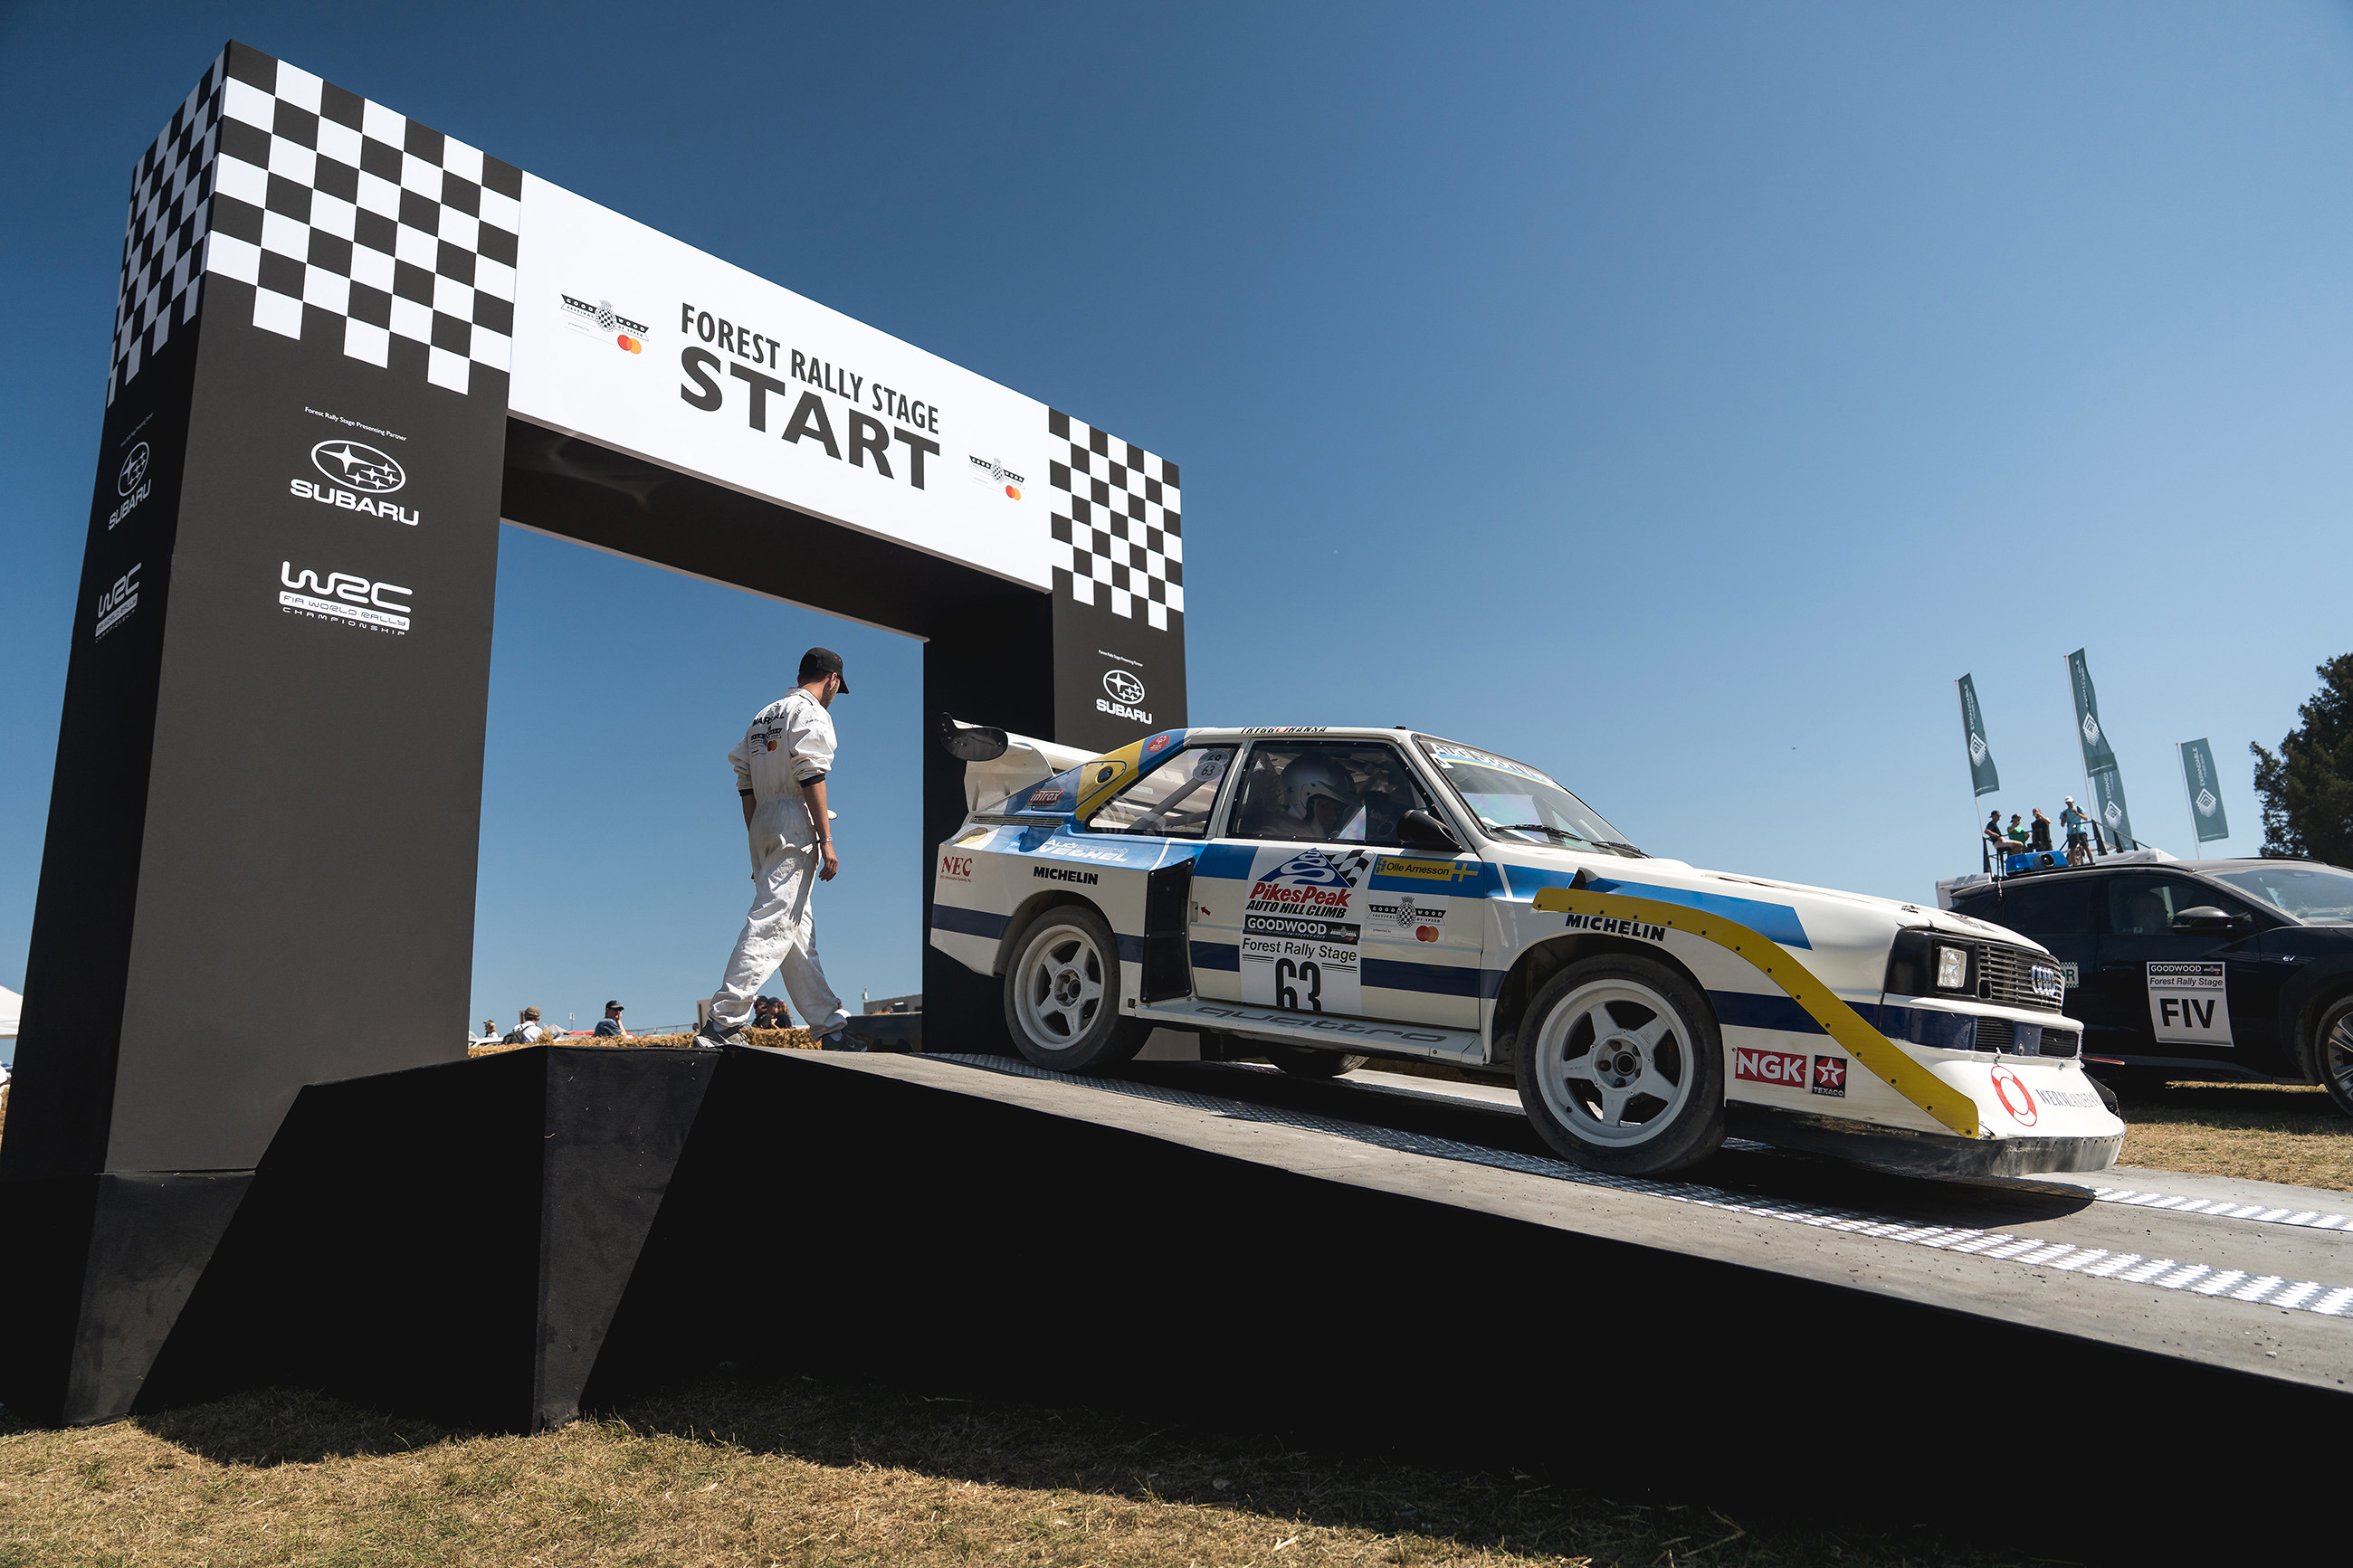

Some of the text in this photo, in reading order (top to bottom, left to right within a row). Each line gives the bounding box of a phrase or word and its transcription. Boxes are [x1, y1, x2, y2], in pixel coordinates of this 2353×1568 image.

[681, 301, 939, 435] FOREST RALLY STAGE
[304, 406, 407, 442] Forest Rally Stage Presenting Partner
[681, 346, 940, 491] START
[108, 479, 152, 531] SUBARU
[290, 479, 420, 527] SUBARU
[98, 562, 142, 619] WRC
[281, 560, 414, 613] WRC
[282, 606, 405, 636] CHAMPIONSHIP
[283, 594, 406, 627] FIA WORLD RALLY
[1096, 698, 1153, 725] SUBARU
[1200, 765, 1215, 776] 63
[941, 855, 973, 877] NEC
[1033, 866, 1099, 886] MICHELIN
[1386, 862, 1404, 872] Olle
[1405, 864, 1450, 876] Arnesson
[1245, 899, 1348, 918] AUTO HILL CLIMB
[1247, 917, 1328, 936] GOODWOOD
[1565, 914, 1666, 942] MICHELIN
[1242, 937, 1358, 964] Forest Rally Stage
[2149, 977, 2224, 988] Forest Rally Stage
[2150, 965, 2202, 973] GOODWOOD
[1275, 957, 1322, 1012] 63
[1195, 1006, 1448, 1042] quattro
[2159, 998, 2216, 1029] FIV
[1738, 1050, 1804, 1083] NGK
[1813, 1086, 1844, 1097] TEXACO
